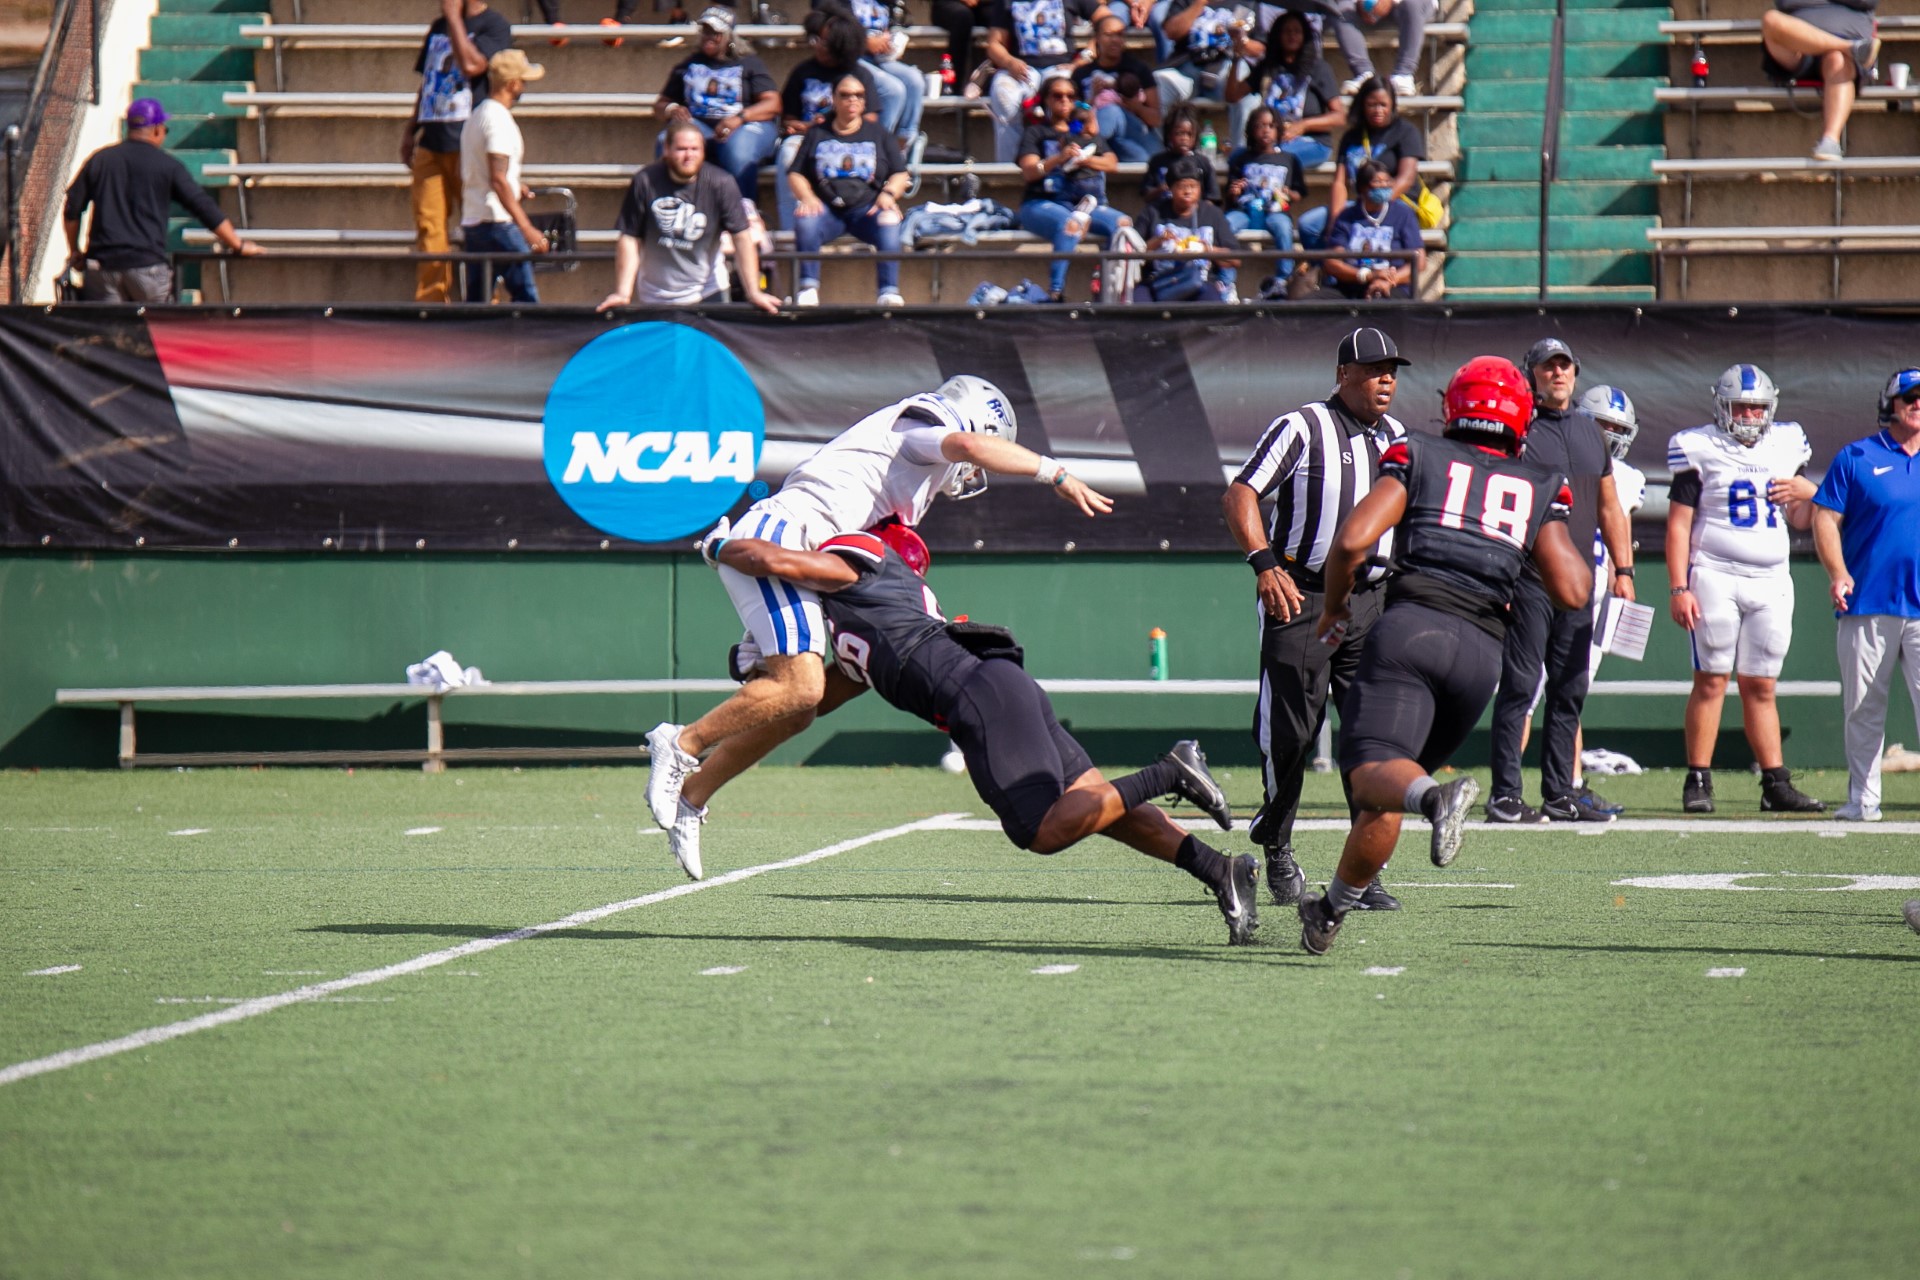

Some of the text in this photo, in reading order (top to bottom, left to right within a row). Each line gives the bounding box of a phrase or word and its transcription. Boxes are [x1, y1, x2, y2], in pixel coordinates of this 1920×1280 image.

[1458, 417, 1505, 435] Riddell
[562, 430, 755, 483] NCAA
[1342, 451, 1353, 465] S
[1441, 460, 1535, 551] 18
